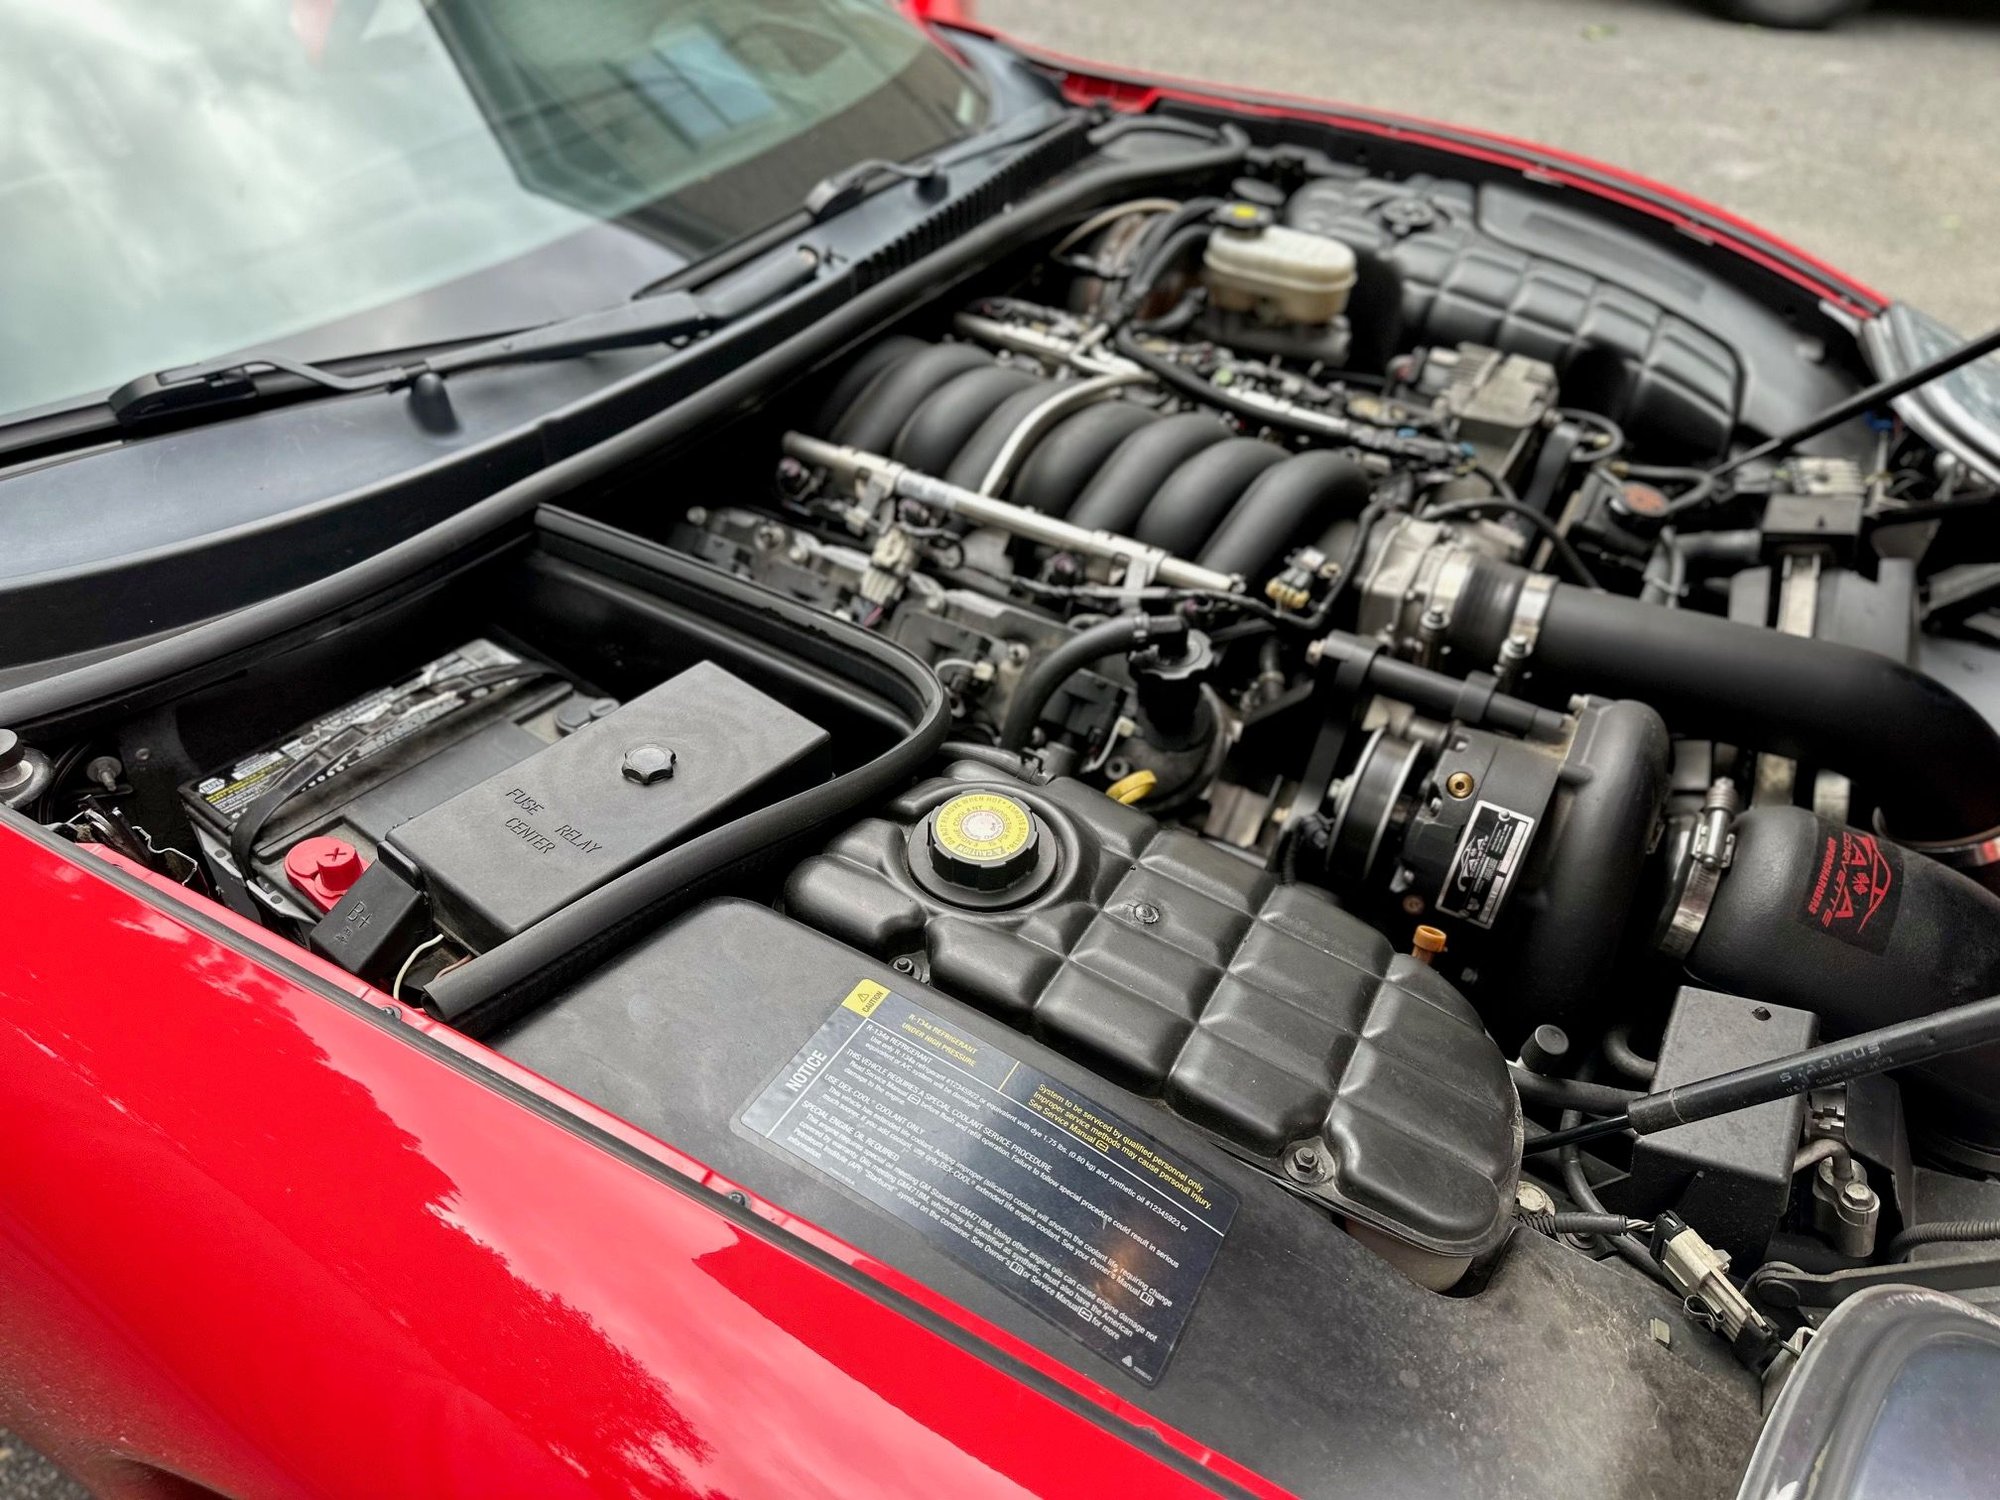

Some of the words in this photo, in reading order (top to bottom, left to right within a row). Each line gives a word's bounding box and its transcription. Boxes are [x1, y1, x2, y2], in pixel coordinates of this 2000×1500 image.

[505, 788, 545, 815] FUSE
[554, 824, 603, 854] RELAY
[963, 796, 984, 804] WHEN
[986, 796, 1001, 804] HOT
[504, 817, 556, 854] CENTER
[957, 844, 993, 857] CAUTION
[1822, 831, 1852, 928] CORVETTE
[346, 900, 373, 928] B+
[861, 989, 884, 1013] CAUTION
[865, 1023, 891, 1041] R-134a
[888, 1036, 933, 1064] REFRIGERANT
[900, 1021, 927, 1039] UNDER
[923, 1034, 942, 1048] HIGH
[940, 1043, 977, 1067] PRESSURE
[907, 1013, 934, 1030] R-134a
[931, 1026, 978, 1055] REFRIGERANT
[1780, 1042, 1880, 1083] STABILUS
[783, 1048, 828, 1093] NOTICE
[800, 1099, 830, 1120] SPECIAL
[827, 1115, 855, 1135] ENGINE
[852, 1130, 866, 1142] OIL
[863, 1137, 901, 1162] REQUIRED
[822, 1073, 839, 1085] USE
[873, 1102, 908, 1125] COOLANT
[905, 1120, 926, 1136] ONLY
[845, 1047, 863, 1061] THIS
[859, 1056, 889, 1076] VEHICLE
[886, 1071, 919, 1094] REQUIRES
[916, 1088, 926, 1098] A
[923, 1092, 952, 1112] SPECIAL
[950, 1108, 983, 1131] COOLANT
[981, 1126, 1012, 1148] SERVICE
[1009, 1143, 1053, 1173] PROCEDURE
[1027, 1098, 1043, 1111] See
[1041, 1106, 1070, 1128] Service
[1068, 1123, 1096, 1144] Manual
[863, 1068, 887, 1085] Service
[885, 1080, 909, 1097] Manual
[954, 1120, 968, 1132] and
[966, 1127, 982, 1140] refill
[979, 1135, 1012, 1160] operation.
[1010, 1154, 1033, 1171] Failure
[1031, 1166, 1041, 1176] to
[1038, 1171, 1060, 1188] follow
[1057, 1183, 1082, 1204] special
[1079, 1197, 1113, 1224] procedure
[1111, 1218, 1132, 1235] could
[1129, 1230, 1149, 1248] result
[1147, 1242, 1157, 1253] in
[1155, 1247, 1180, 1269] serious
[984, 1100, 1018, 1124] equivalent
[1015, 1118, 1031, 1131] with
[1028, 1126, 1043, 1139] dye
[1042, 1134, 1058, 1147] 1.75
[1056, 1142, 1070, 1154] lbs.
[1083, 1160, 1096, 1173] kg)
[1094, 1167, 1109, 1180] and
[1106, 1175, 1137, 1199] synthetic
[1135, 1193, 1146, 1203] oil
[1143, 1198, 1181, 1227] #12345923
[1179, 1223, 1189, 1233] or
[1031, 1090, 1065, 1115] Improper
[1063, 1109, 1091, 1130] service
[1089, 1125, 1122, 1149] methods
[1119, 1145, 1137, 1161] may
[1136, 1156, 1159, 1174] cause
[1157, 1169, 1191, 1196] personal
[1188, 1190, 1213, 1211] injury.
[1036, 1082, 1065, 1104] System
[1063, 1098, 1074, 1108] to
[1071, 1103, 1084, 1114] be
[1082, 1109, 1113, 1133] serviced
[1111, 1128, 1123, 1140] by
[1120, 1134, 1153, 1160] qualified
[1151, 1153, 1188, 1183] personnel
[1186, 1176, 1206, 1195] only.
[923, 1152, 939, 1166] only
[973, 1183, 1005, 1205] extended
[1002, 1200, 1016, 1212] life
[1012, 1207, 1037, 1228] engine
[1035, 1221, 1062, 1243] coolant.
[1060, 1237, 1076, 1252] See
[1072, 1248, 1089, 1263] your
[1088, 1256, 1117, 1280] Owner's
[1115, 1275, 1141, 1297] Manual
[932, 1147, 957, 1166] Adding
[953, 1160, 984, 1183] improper
[981, 1177, 1014, 1202] (silicated)
[1012, 1196, 1037, 1215] coolant
[1035, 1210, 1049, 1223] will
[1047, 1218, 1073, 1239] shorten
[1071, 1234, 1084, 1247] the
[1082, 1242, 1108, 1262] coolant
[1106, 1257, 1121, 1271] life,
[1118, 1266, 1149, 1292] requiring
[1147, 1285, 1173, 1309] change
[895, 1189, 921, 1209] symbol
[918, 1204, 929, 1214] on
[927, 1209, 941, 1221] the
[939, 1216, 972, 1240] container.
[969, 1235, 985, 1249] See
[983, 1244, 1012, 1266] Owner's
[1021, 1270, 1031, 1280] or
[1029, 1274, 1056, 1296] Service
[1054, 1291, 1080, 1313] Manual
[1090, 1316, 1103, 1329] for
[1100, 1324, 1120, 1341] more
[917, 1180, 932, 1192] GM
[929, 1187, 960, 1210] Standard
[991, 1226, 1013, 1245] Using
[1010, 1238, 1030, 1255] other
[1027, 1249, 1052, 1271] engine
[1050, 1265, 1064, 1278] oils
[1062, 1274, 1076, 1287] can
[1075, 1282, 1096, 1301] cause
[1094, 1295, 1119, 1317] engine
[1116, 1310, 1146, 1336] damage
[1144, 1329, 1158, 1343] not
[929, 1198, 951, 1215] which
[947, 1211, 964, 1226] may
[963, 1220, 975, 1231] be
[972, 1225, 1004, 1249] identified
[1002, 1245, 1012, 1255] as
[1010, 1250, 1044, 1278] synthetic,
[1041, 1271, 1061, 1287] must
[1058, 1282, 1075, 1297] also
[1073, 1291, 1091, 1308] have
[1089, 1303, 1103, 1316] the
[1101, 1311, 1134, 1338] American
